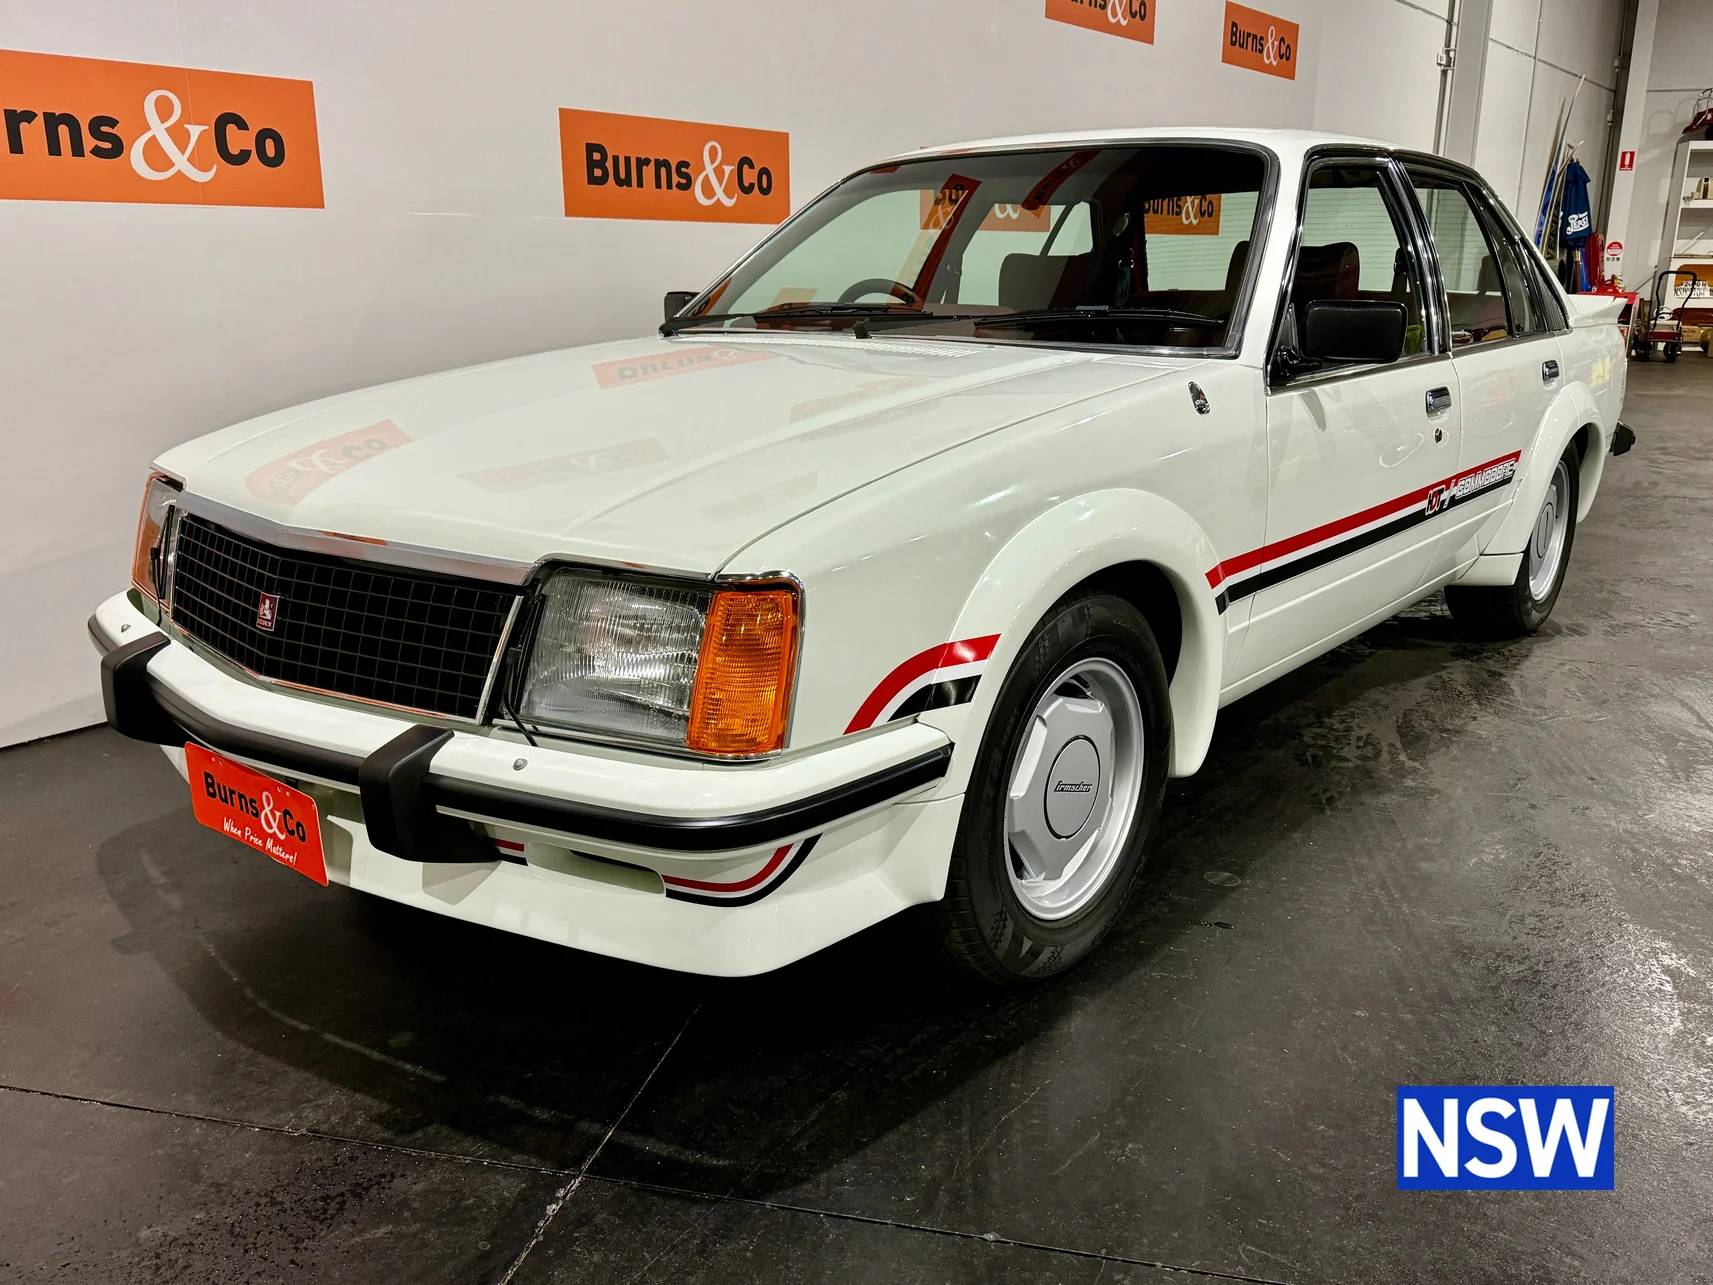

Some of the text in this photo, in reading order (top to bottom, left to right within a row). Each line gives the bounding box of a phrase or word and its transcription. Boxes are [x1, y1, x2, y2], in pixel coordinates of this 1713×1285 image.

[1229, 21, 1291, 66] Burns&Co
[4, 89, 286, 183] rns&Co
[585, 140, 773, 208] Burns&Co
[1455, 459, 1517, 499] COMMODORE
[203, 771, 307, 843] Burns&Co
[223, 816, 298, 866] When Price Matters!
